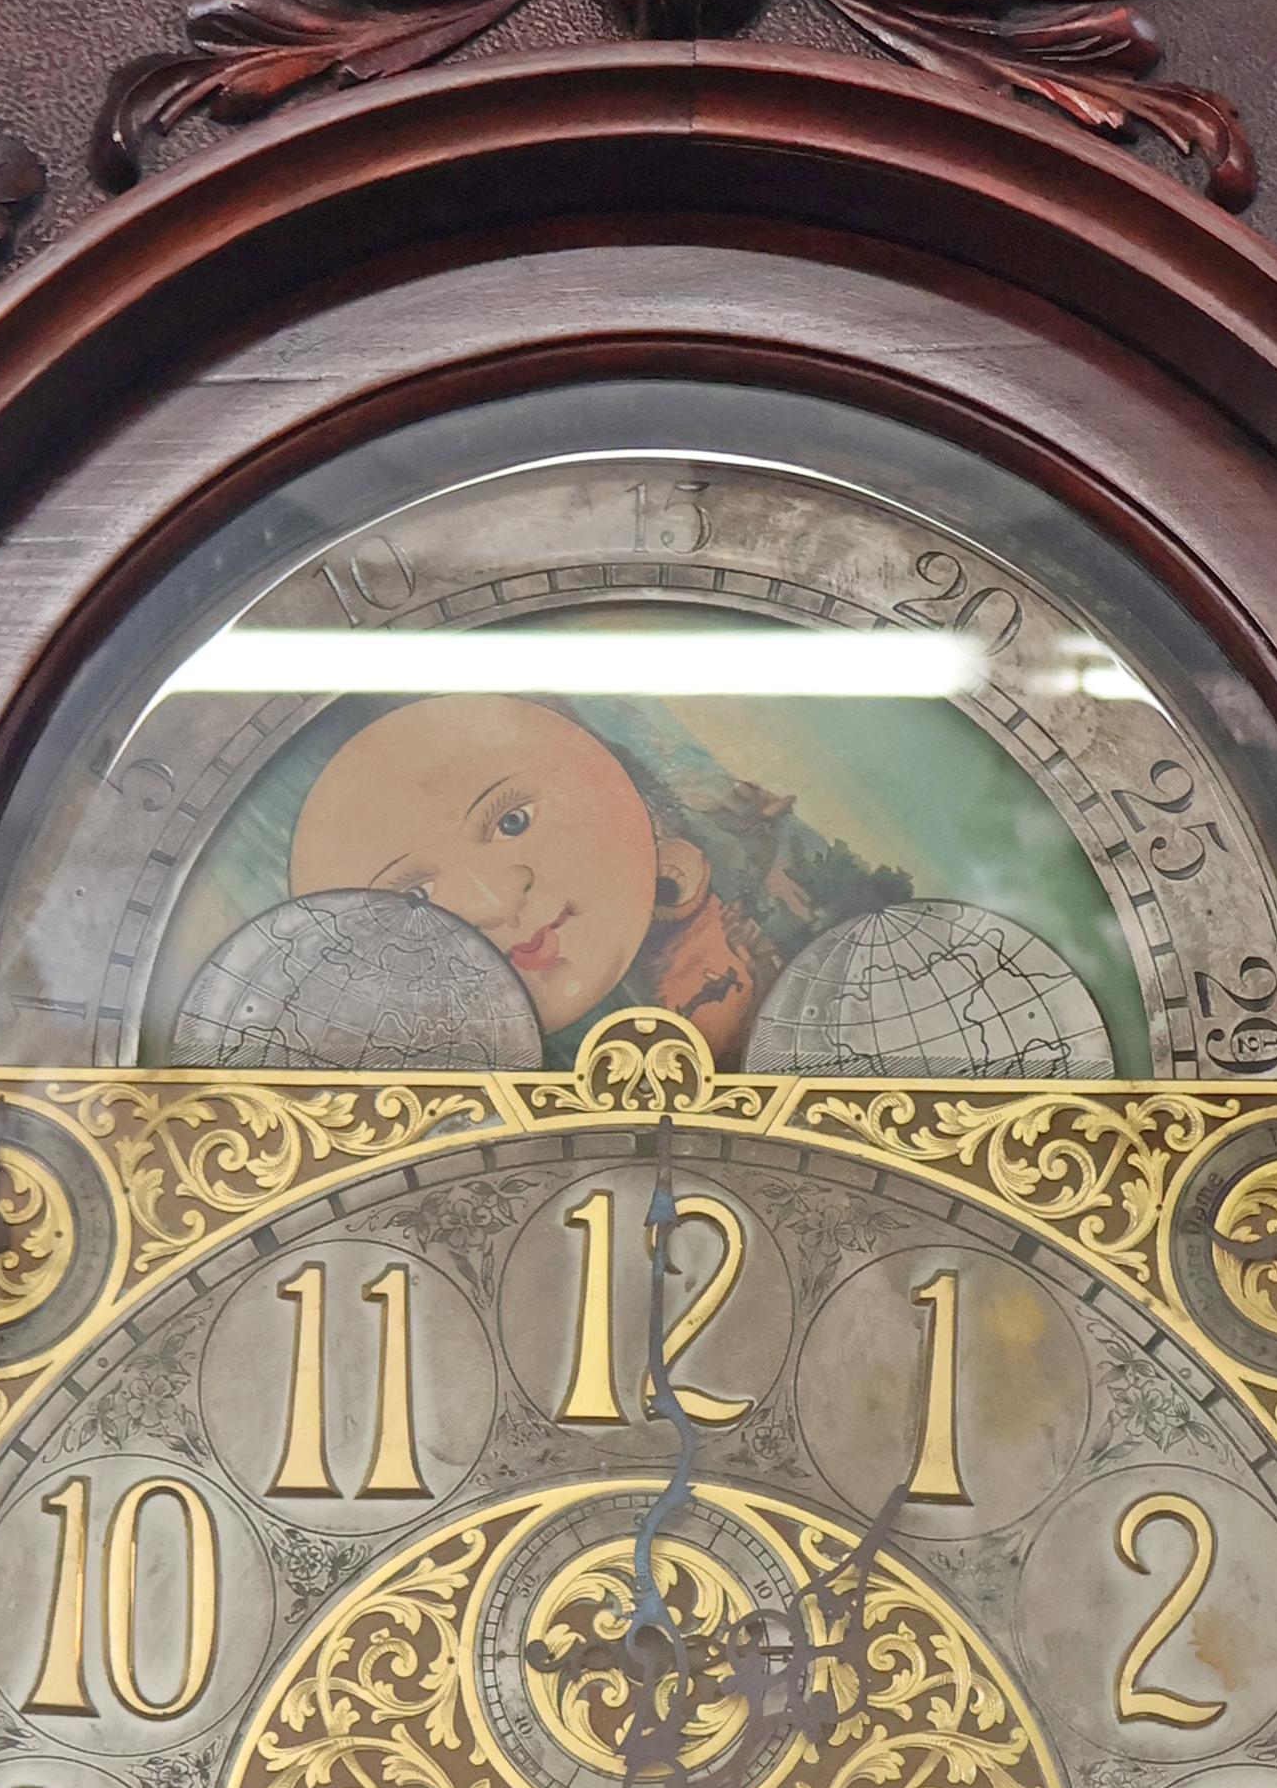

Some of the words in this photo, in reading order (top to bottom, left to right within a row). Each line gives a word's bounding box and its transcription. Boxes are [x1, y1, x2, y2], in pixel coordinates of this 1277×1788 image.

[313, 534, 416, 628] 10
[624, 480, 711, 555] 15
[893, 551, 1022, 657] 20
[1112, 759, 1228, 881] 25
[266, 1261, 433, 1500] 11
[557, 1189, 754, 1428] 12
[906, 1269, 974, 1506] 1
[20, 1475, 220, 1720] 10
[752, 1579, 774, 1600] 10
[1115, 1491, 1226, 1731] 2
